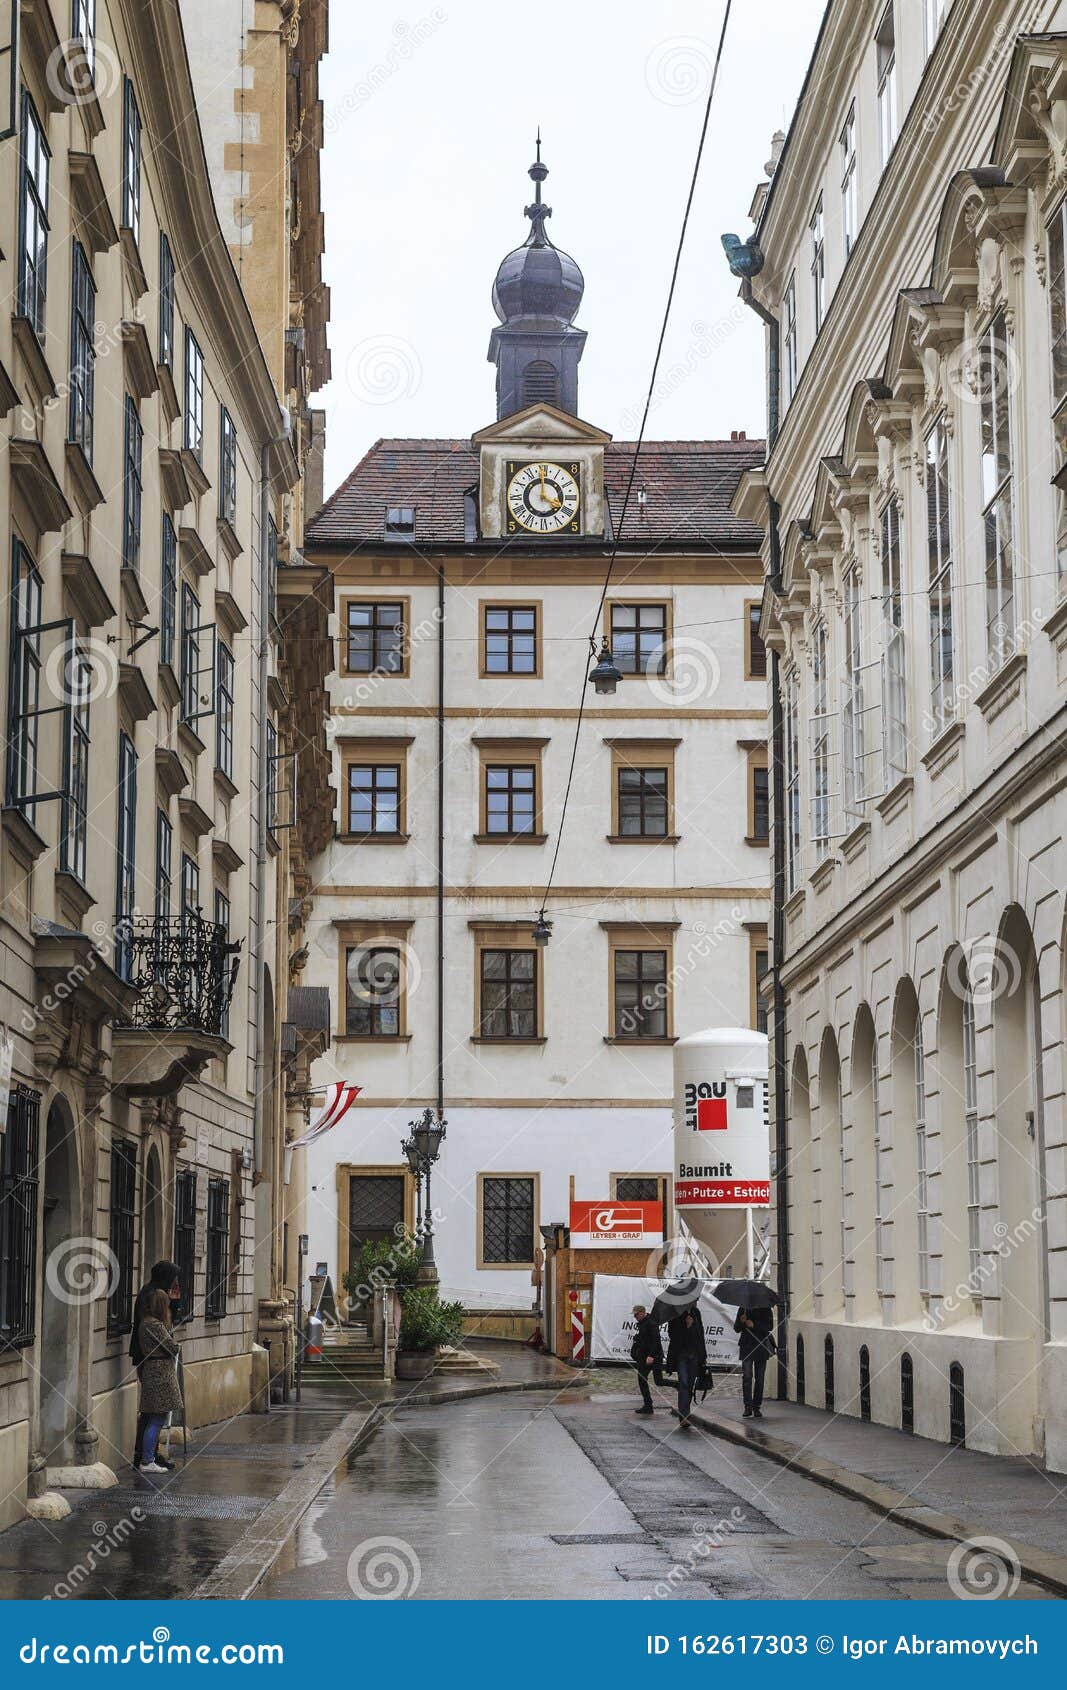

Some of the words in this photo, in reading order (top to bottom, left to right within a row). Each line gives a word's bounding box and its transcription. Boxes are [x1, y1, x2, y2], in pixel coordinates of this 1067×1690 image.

[571, 463, 578, 474] 8
[508, 521, 516, 532] 5
[571, 521, 578, 532] 5
[680, 1162, 733, 1178] Baumit
[693, 1187, 724, 1198] Putze
